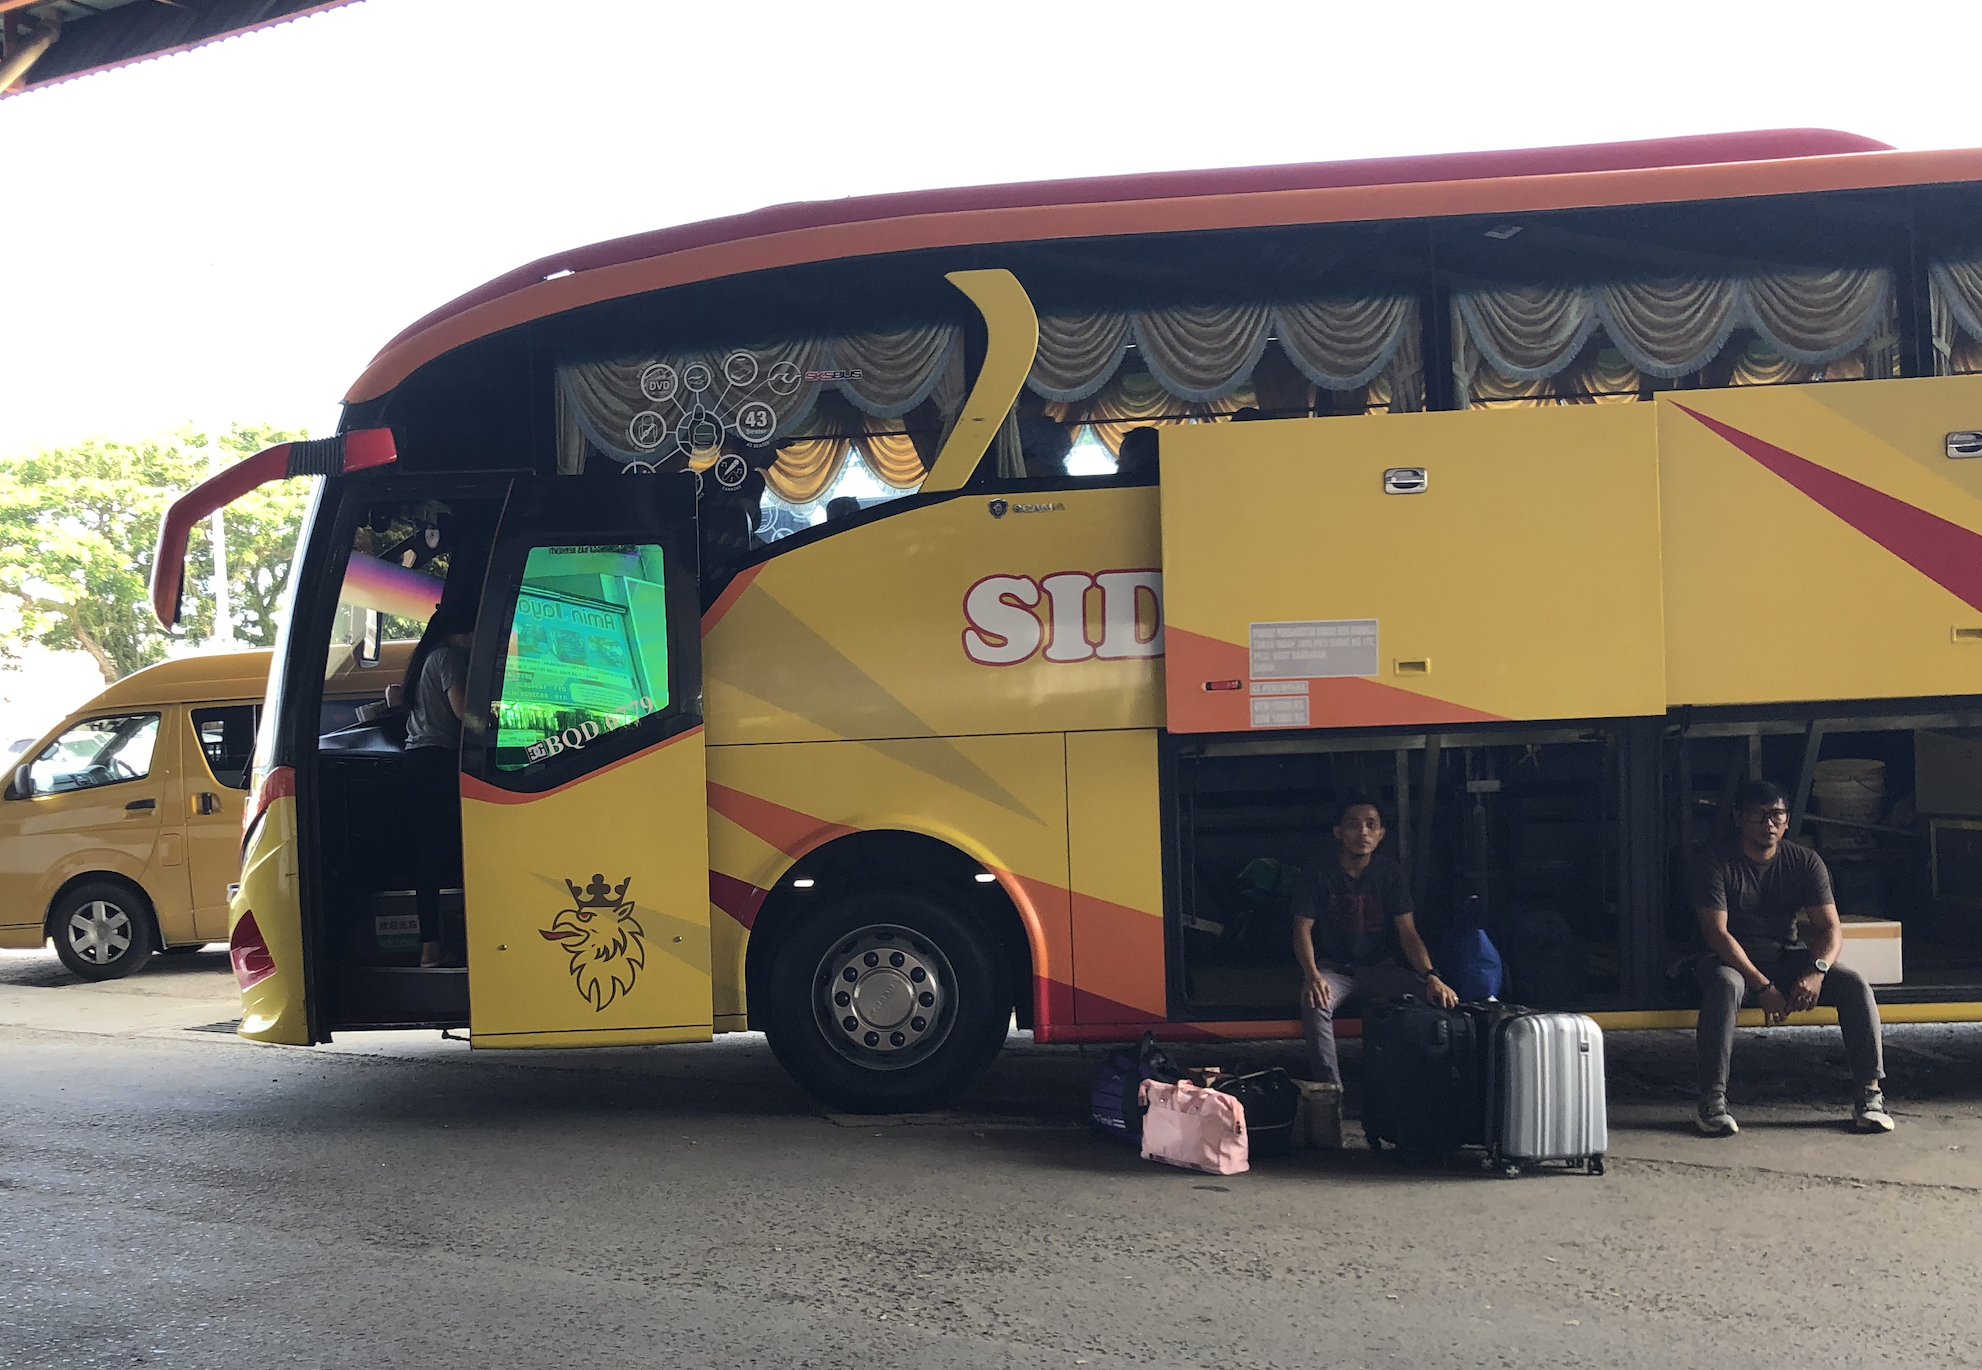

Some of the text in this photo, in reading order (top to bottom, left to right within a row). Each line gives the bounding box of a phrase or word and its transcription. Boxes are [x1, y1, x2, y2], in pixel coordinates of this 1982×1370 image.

[805, 369, 863, 382] SKSBUS
[649, 381, 670, 391] DVD
[745, 411, 768, 428] 43
[962, 568, 1166, 666] SID
[545, 720, 600, 757] BQD
